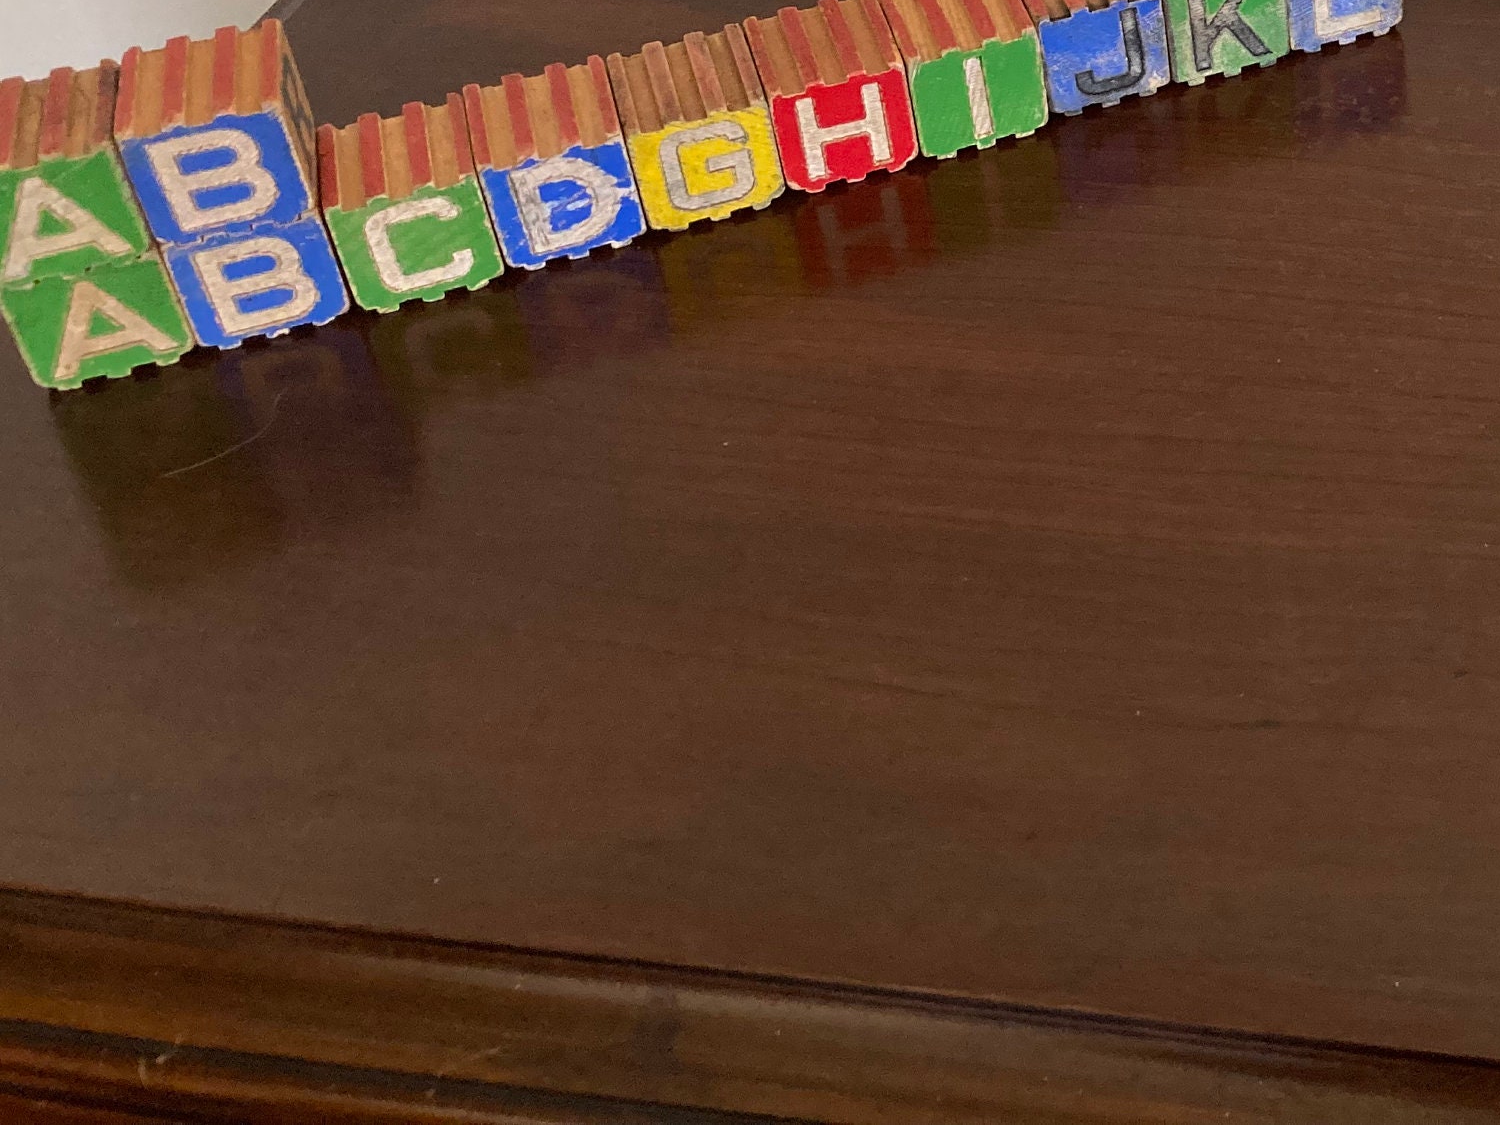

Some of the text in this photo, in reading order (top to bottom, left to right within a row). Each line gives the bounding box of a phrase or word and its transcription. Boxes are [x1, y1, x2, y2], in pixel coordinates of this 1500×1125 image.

[963, 56, 995, 139] I
[1074, 7, 1145, 95] J
[145, 128, 280, 232] B
[659, 119, 755, 210] G
[795, 82, 895, 181] H
[3, 177, 134, 277] A
[364, 197, 473, 292] C
[508, 156, 626, 255] D
[54, 280, 181, 380] A
[194, 237, 320, 336] B
